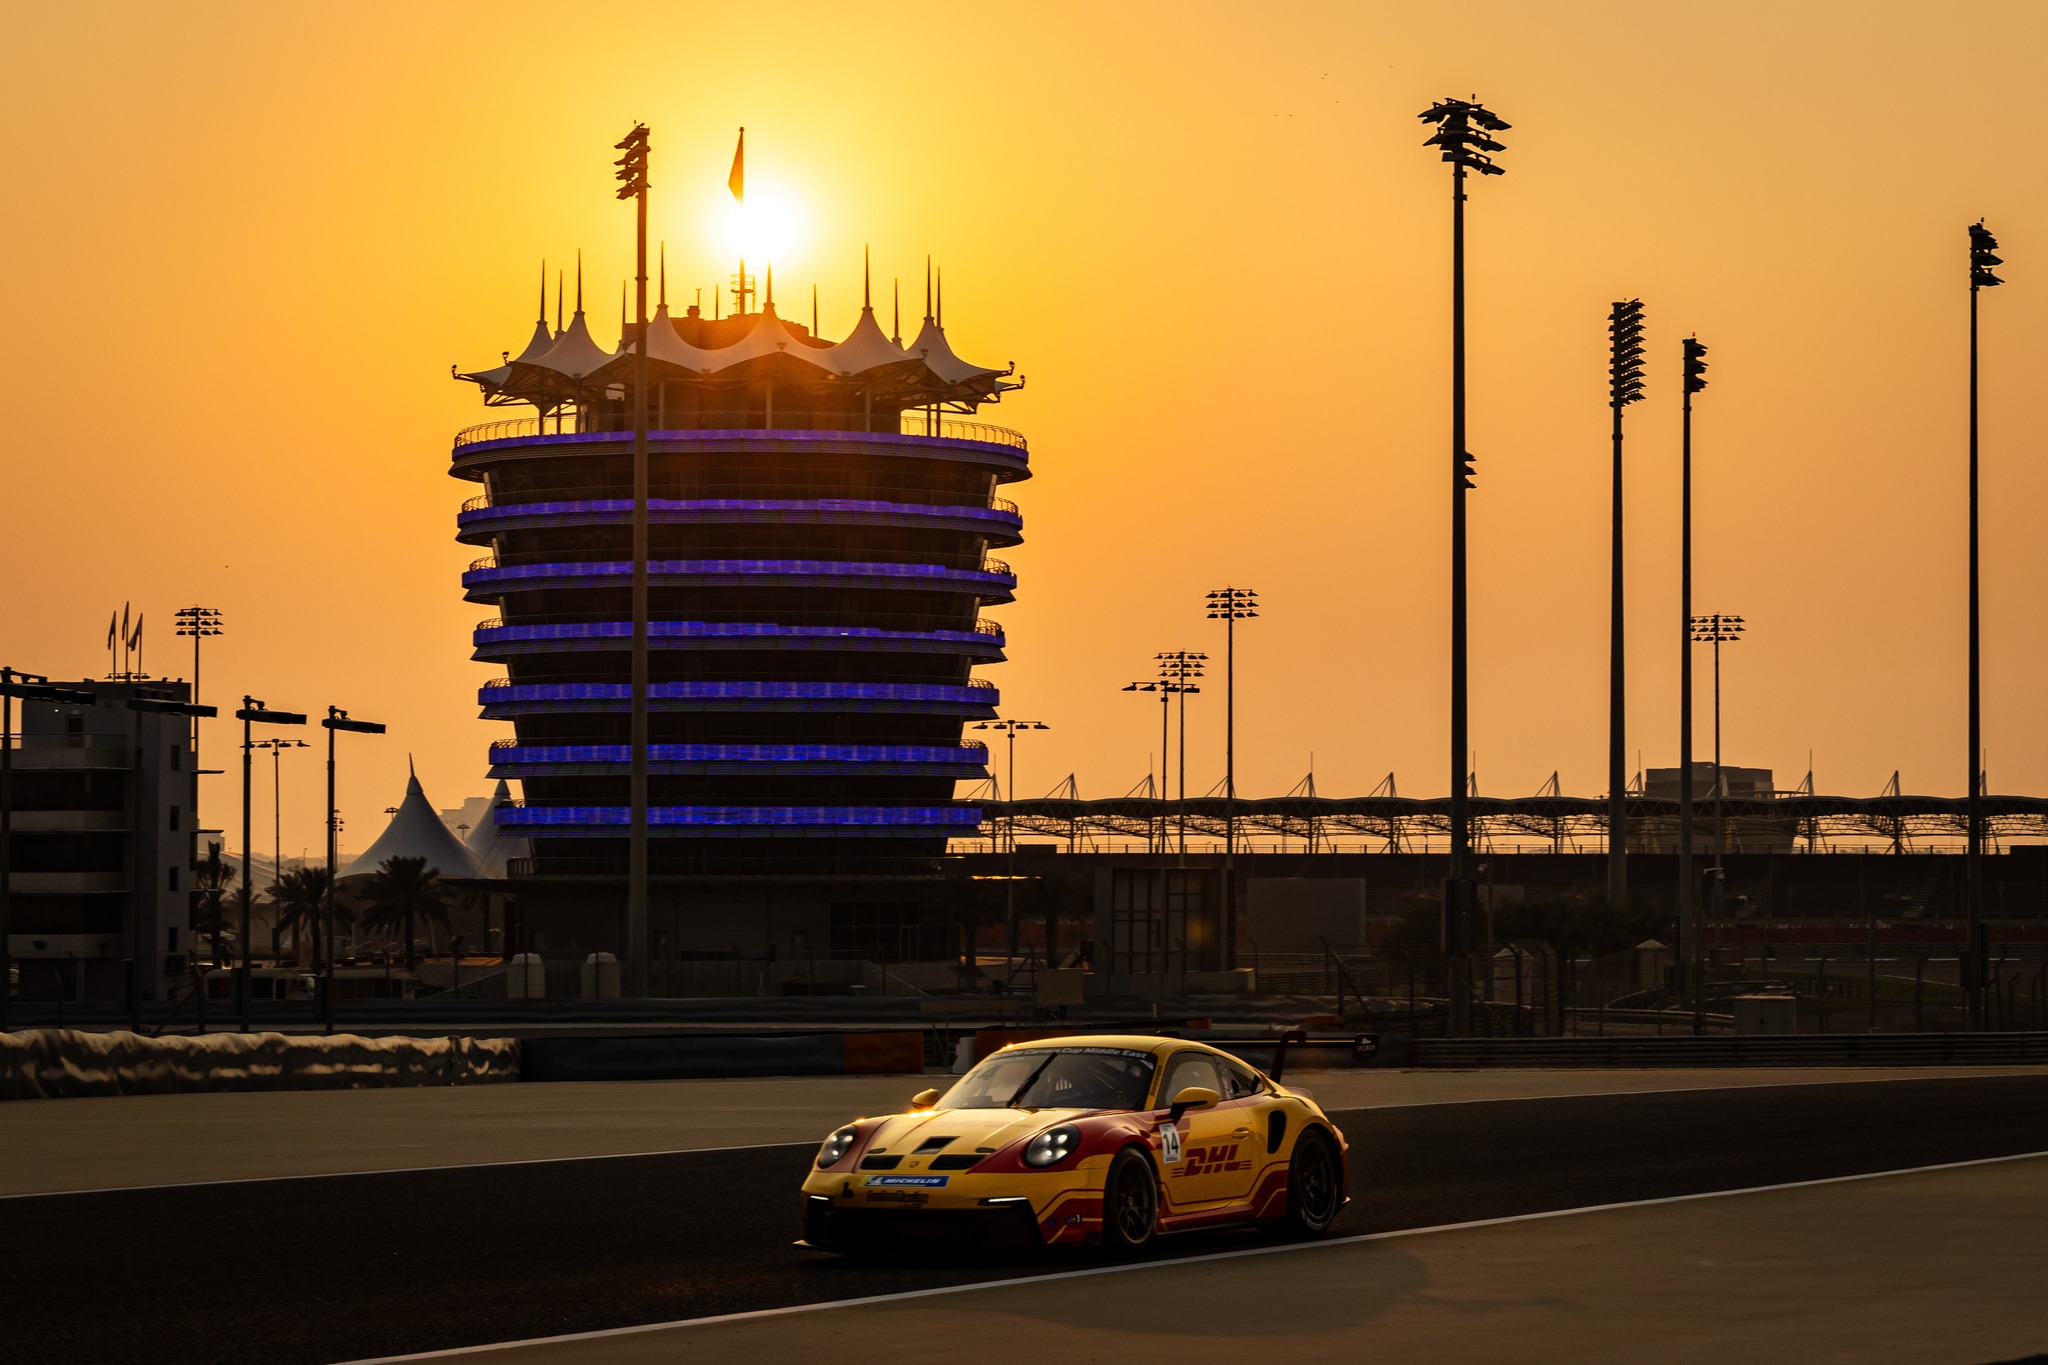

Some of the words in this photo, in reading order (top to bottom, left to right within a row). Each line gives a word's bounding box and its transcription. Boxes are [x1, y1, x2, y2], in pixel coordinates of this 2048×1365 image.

[1061, 1047, 1082, 1055] Cup
[1083, 1047, 1120, 1056] Middle
[1121, 1050, 1148, 1059] East
[1163, 1132, 1179, 1154] 14
[1184, 1144, 1239, 1176] DHL
